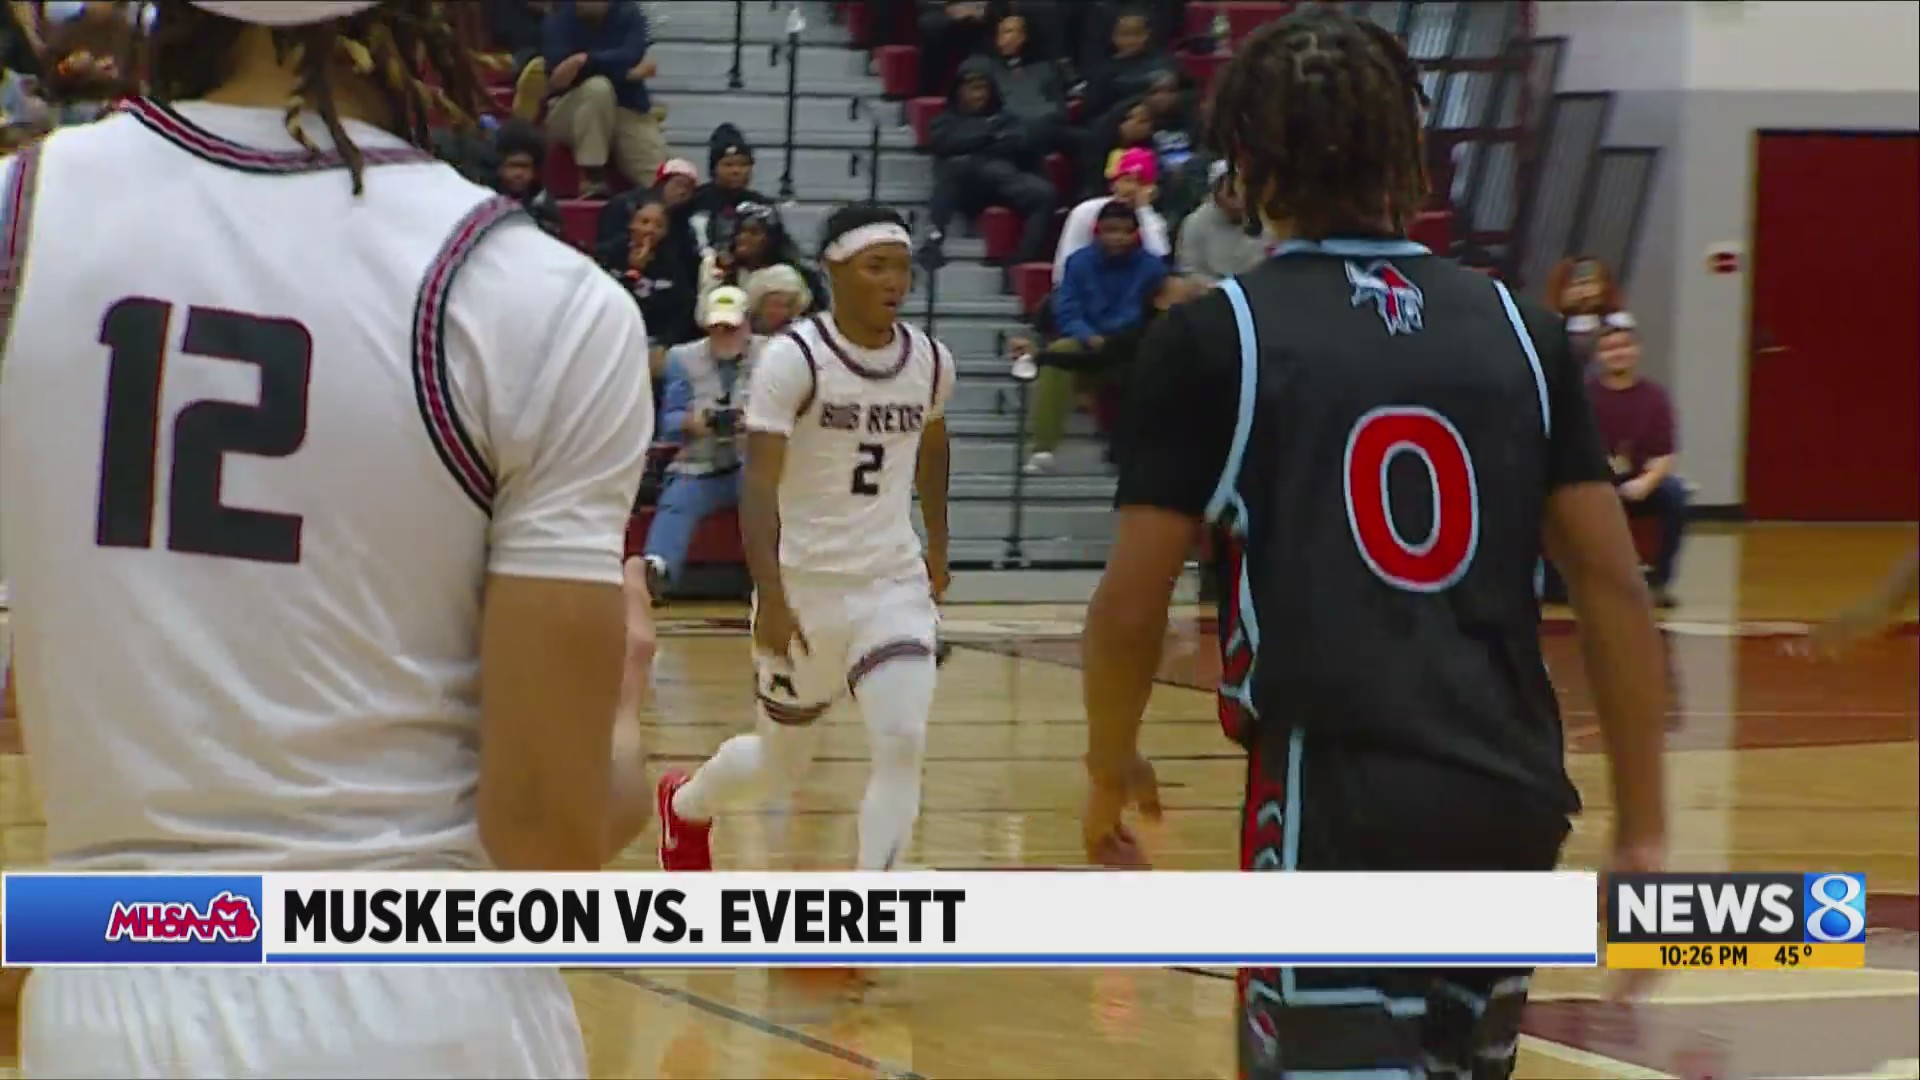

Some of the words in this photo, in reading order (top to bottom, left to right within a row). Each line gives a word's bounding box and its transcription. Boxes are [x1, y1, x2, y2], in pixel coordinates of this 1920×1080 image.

[97, 296, 313, 563] 12
[851, 442, 885, 495] 2
[1343, 405, 1479, 593] 0
